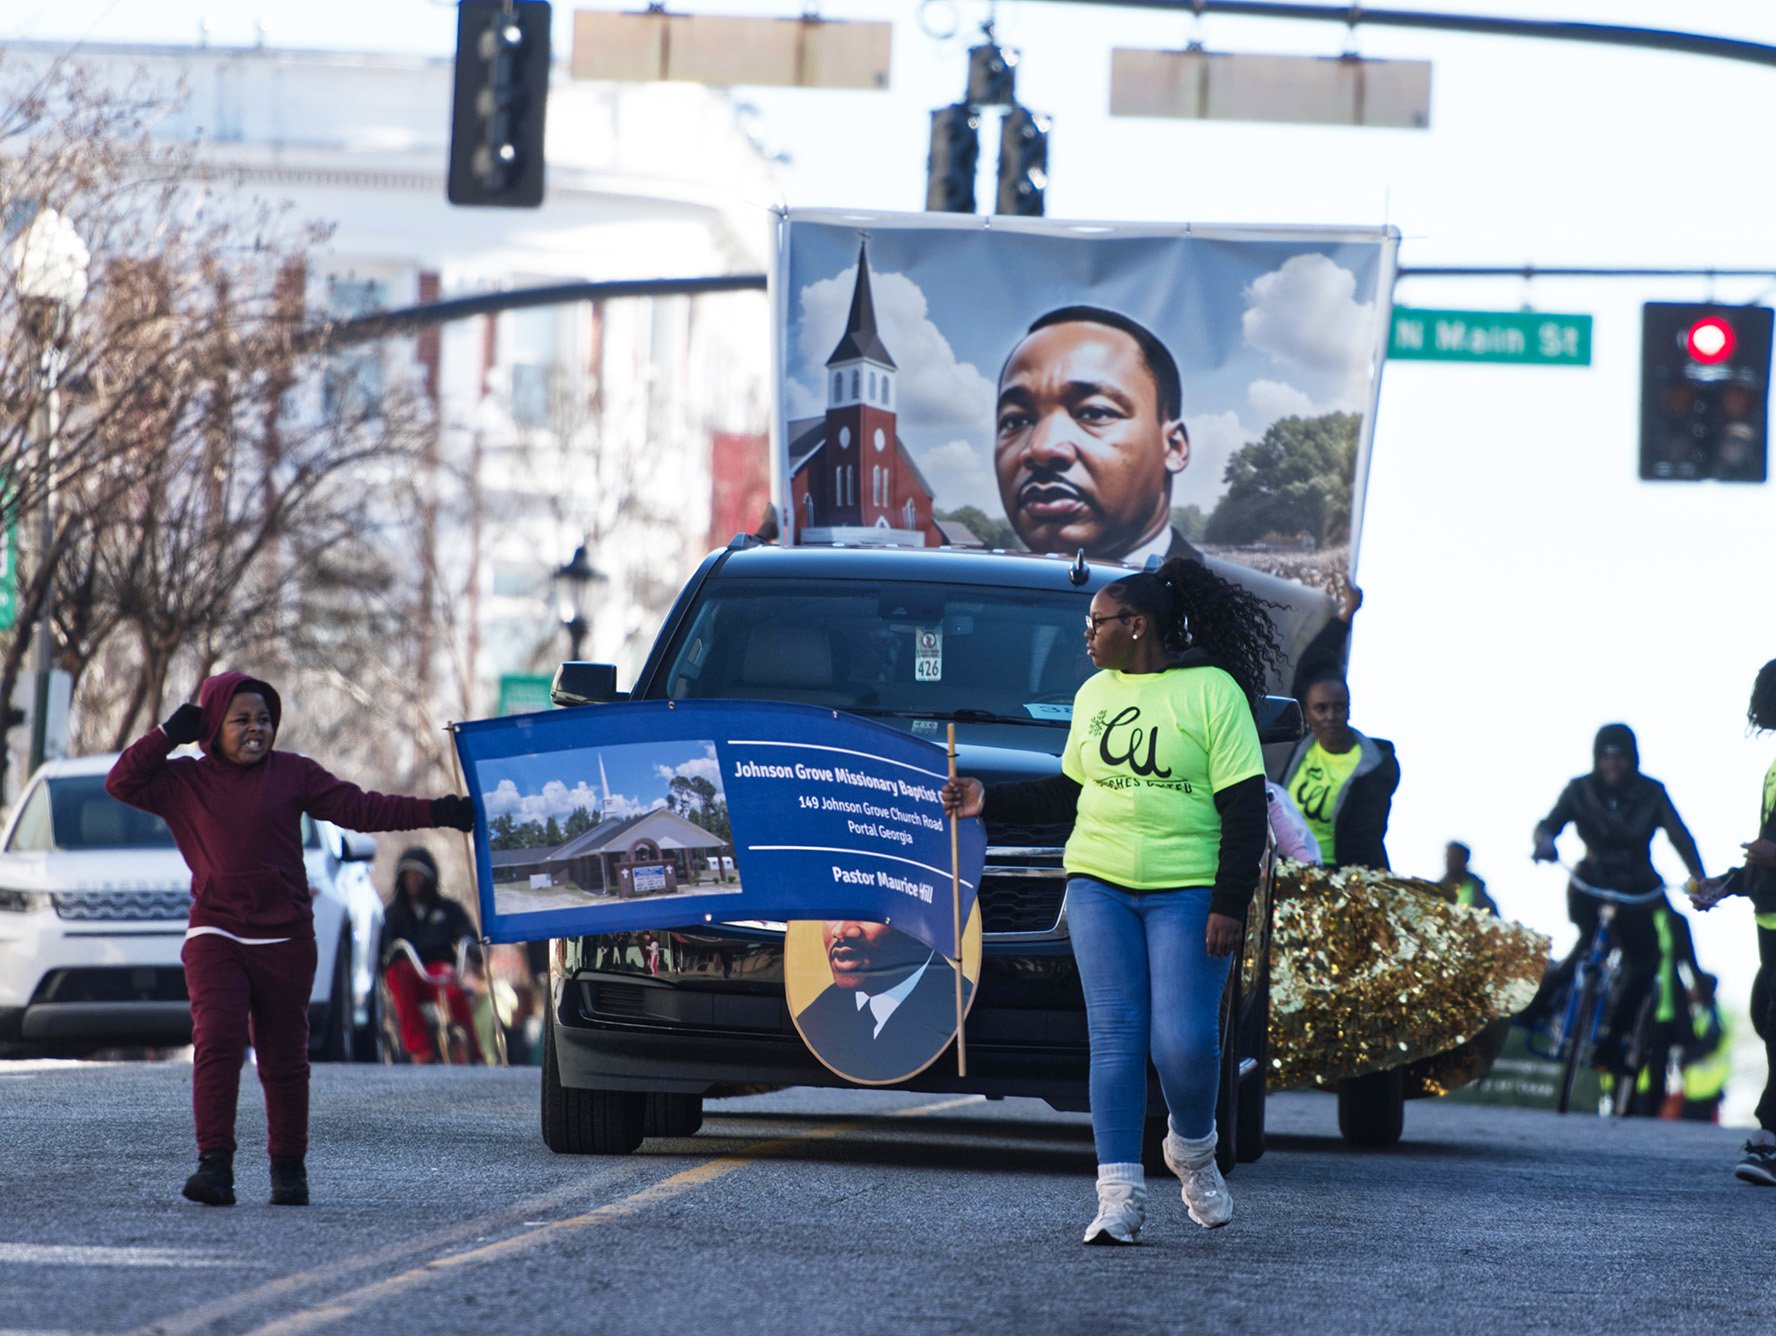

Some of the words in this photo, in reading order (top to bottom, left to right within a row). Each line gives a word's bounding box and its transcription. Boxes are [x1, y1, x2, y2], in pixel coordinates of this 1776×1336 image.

[1395, 318, 1424, 350] N
[1435, 319, 1525, 354] Main
[1538, 322, 1579, 357] St
[918, 660, 939, 677] 426
[735, 760, 794, 778] Johnson
[795, 763, 834, 782] Grove
[834, 767, 898, 797] Missionary
[898, 780, 939, 803] Baptist
[799, 795, 820, 809] 149
[821, 797, 863, 813] Johnson
[863, 802, 890, 818] Grove
[889, 807, 922, 826] Church
[922, 814, 944, 831] Road
[847, 820, 878, 837] Portal
[878, 825, 913, 845] Georgia
[832, 866, 875, 886] Pastor
[877, 871, 919, 898] Maurice
[919, 883, 934, 904] Hill
